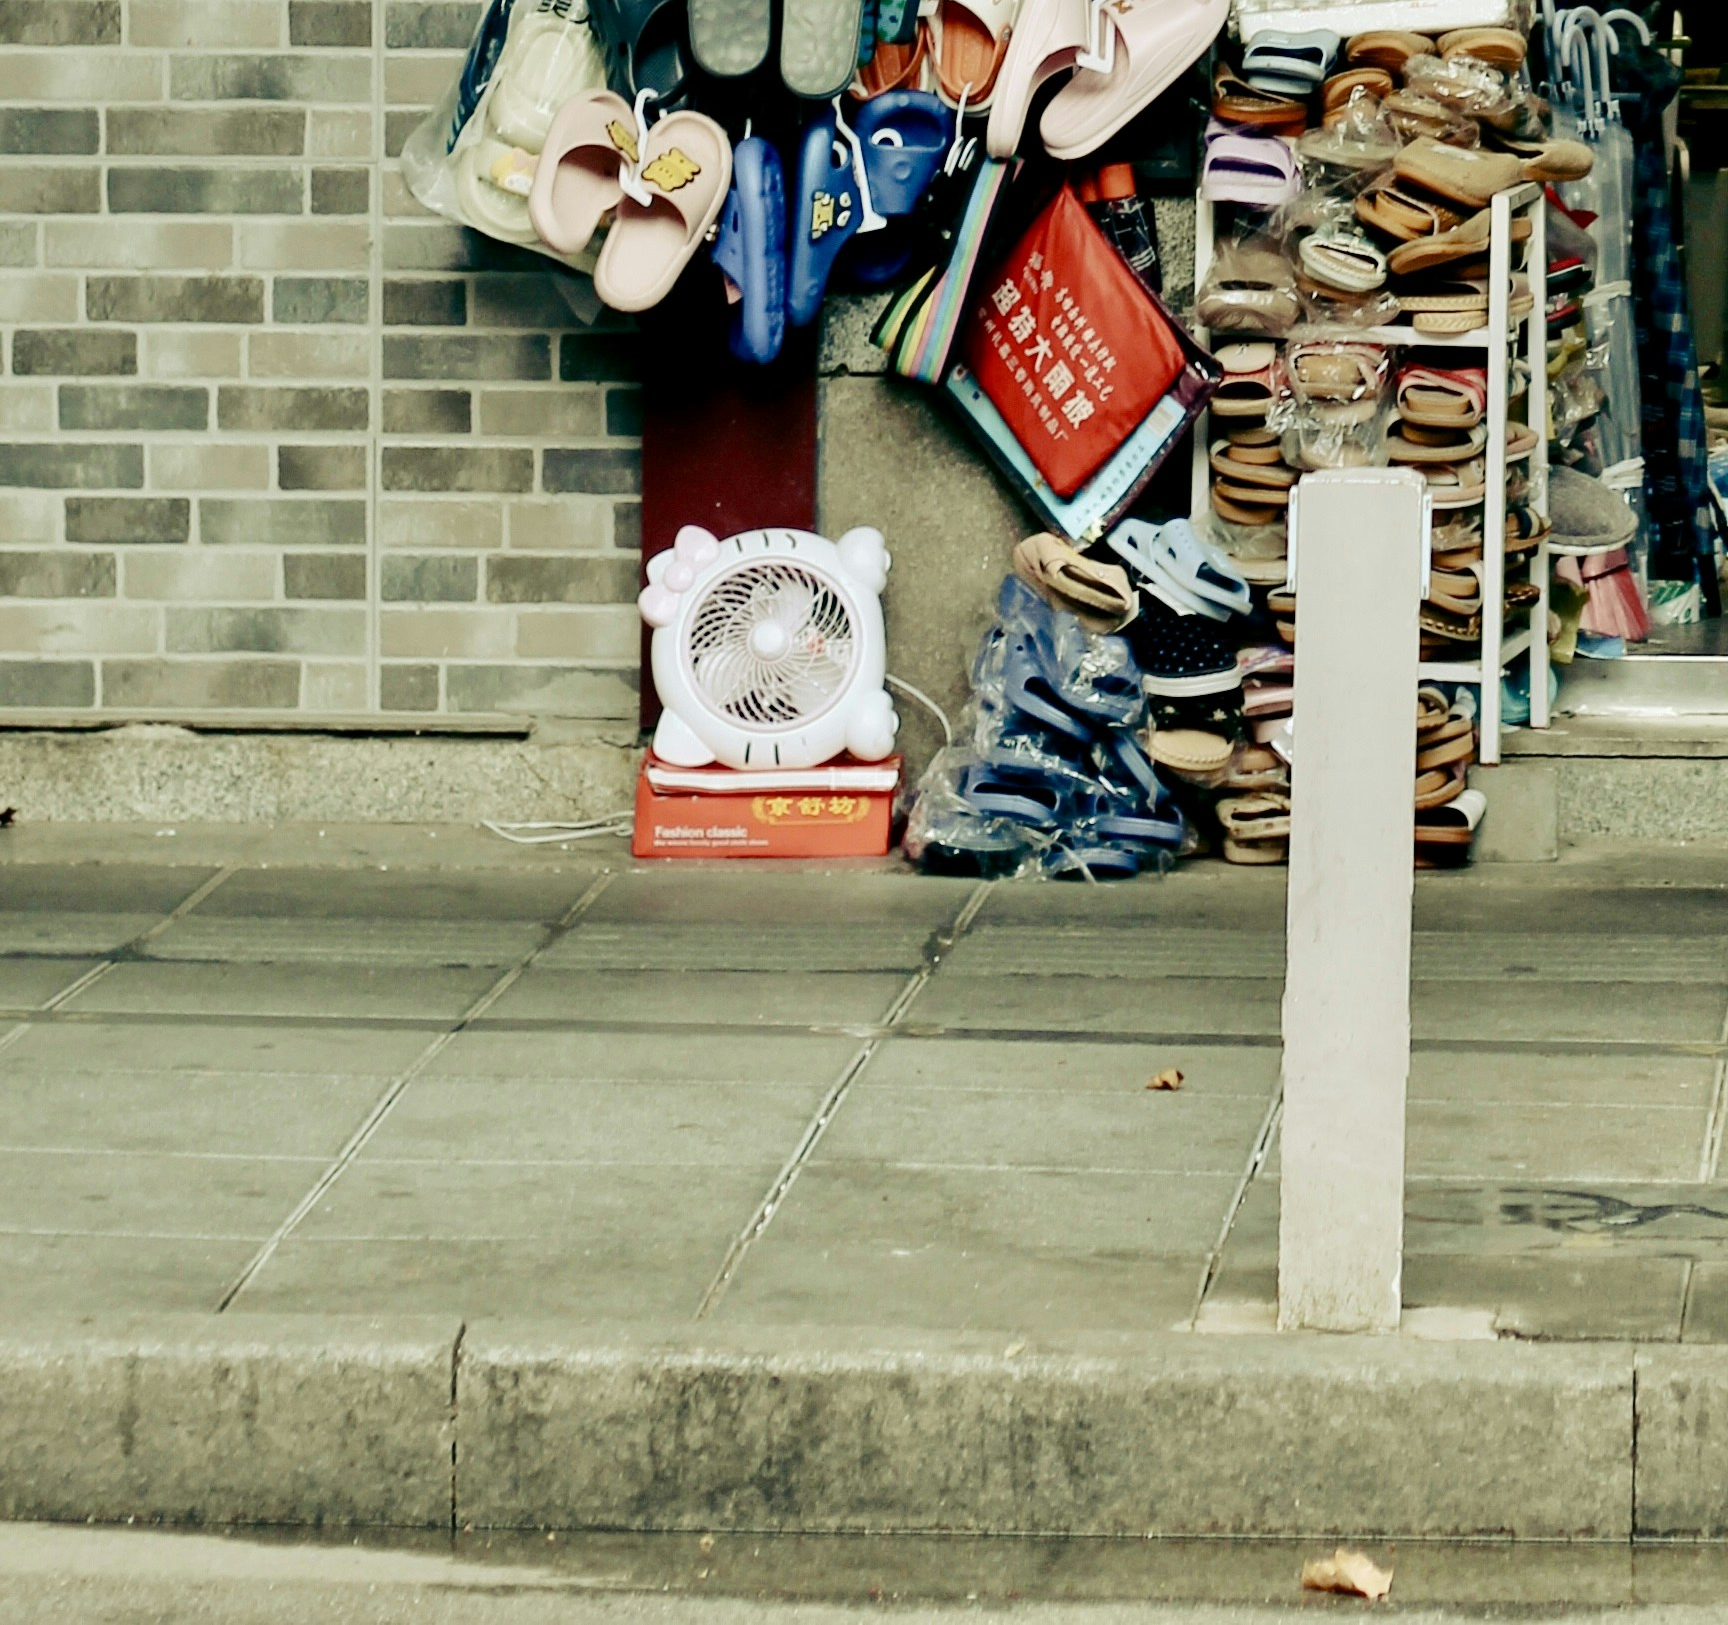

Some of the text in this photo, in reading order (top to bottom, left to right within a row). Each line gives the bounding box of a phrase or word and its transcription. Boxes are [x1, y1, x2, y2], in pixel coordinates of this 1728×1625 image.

[990, 277, 1097, 431] 超特大雨披
[654, 825, 748, 838] Fashion classic
